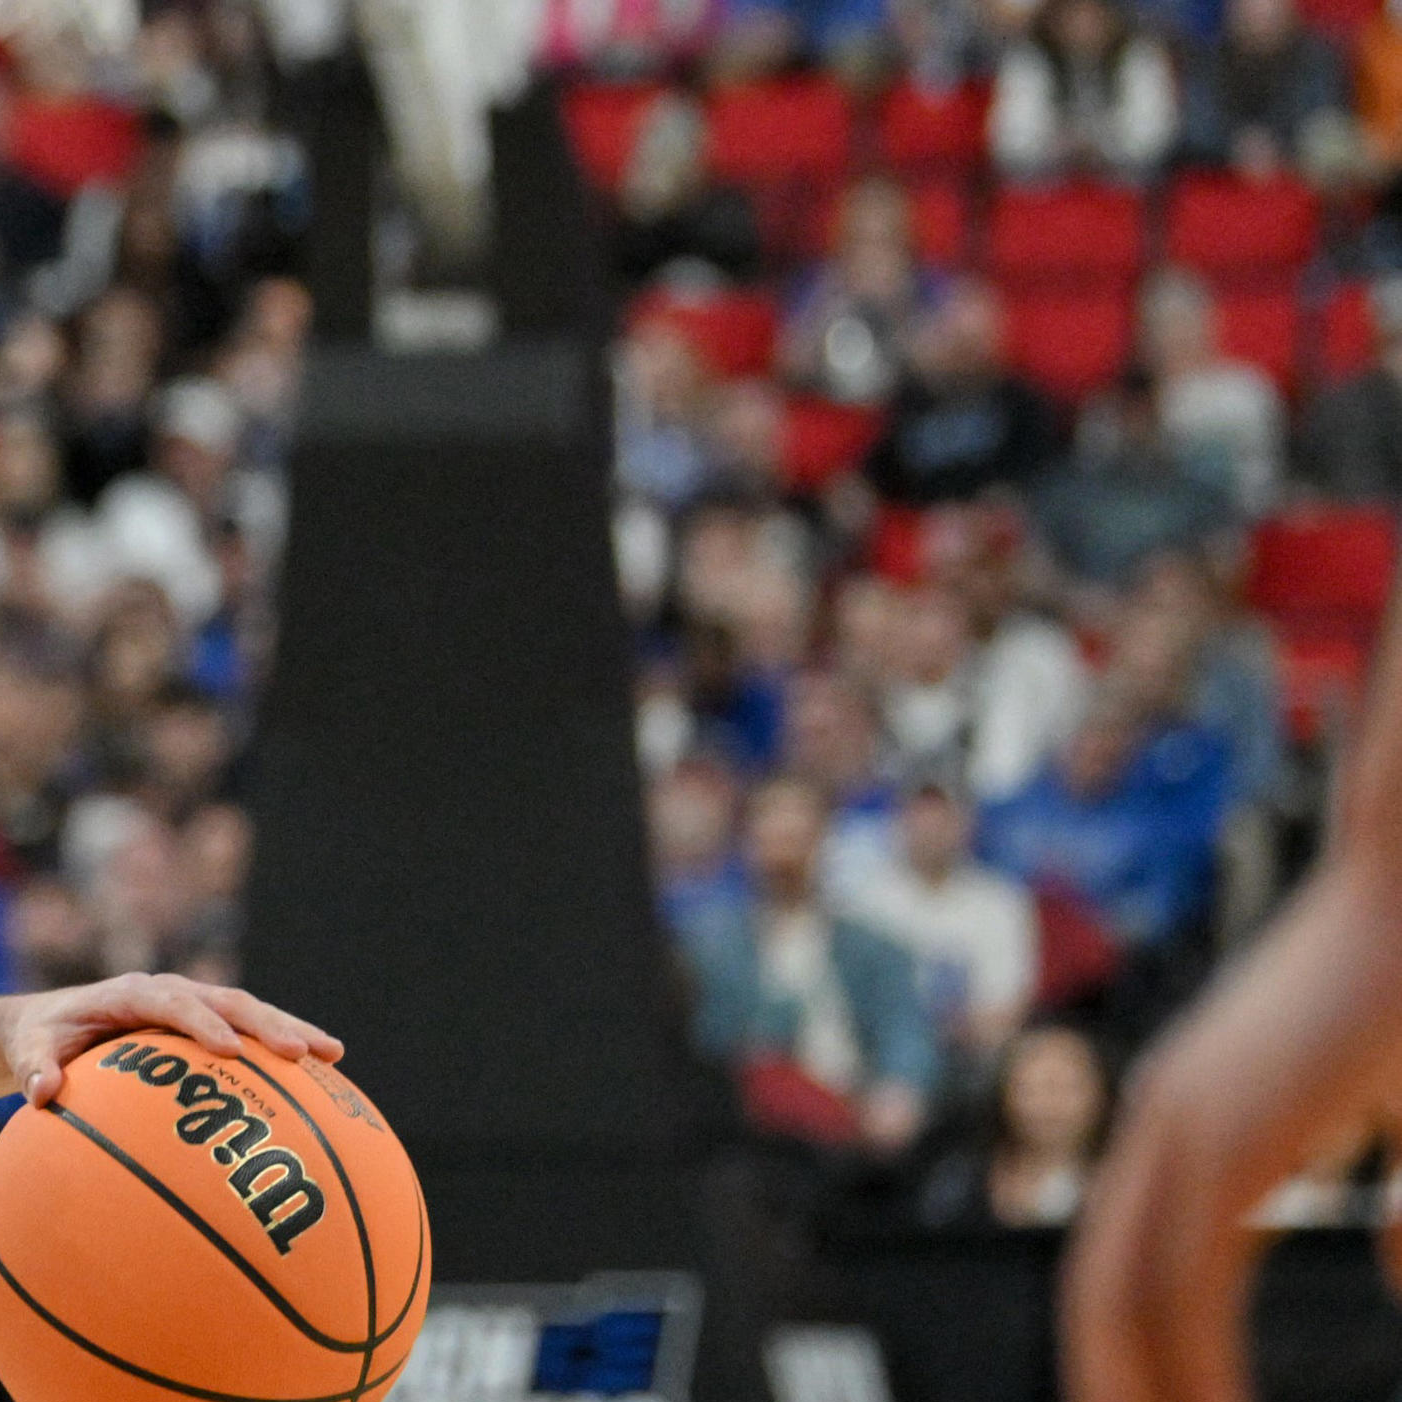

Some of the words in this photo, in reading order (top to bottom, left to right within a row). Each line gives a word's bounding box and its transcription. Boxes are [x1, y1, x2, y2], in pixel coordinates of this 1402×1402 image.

[205, 1062, 240, 1086] NXT
[242, 1087, 276, 1118] EVO
[98, 1042, 325, 1257] Wilson
